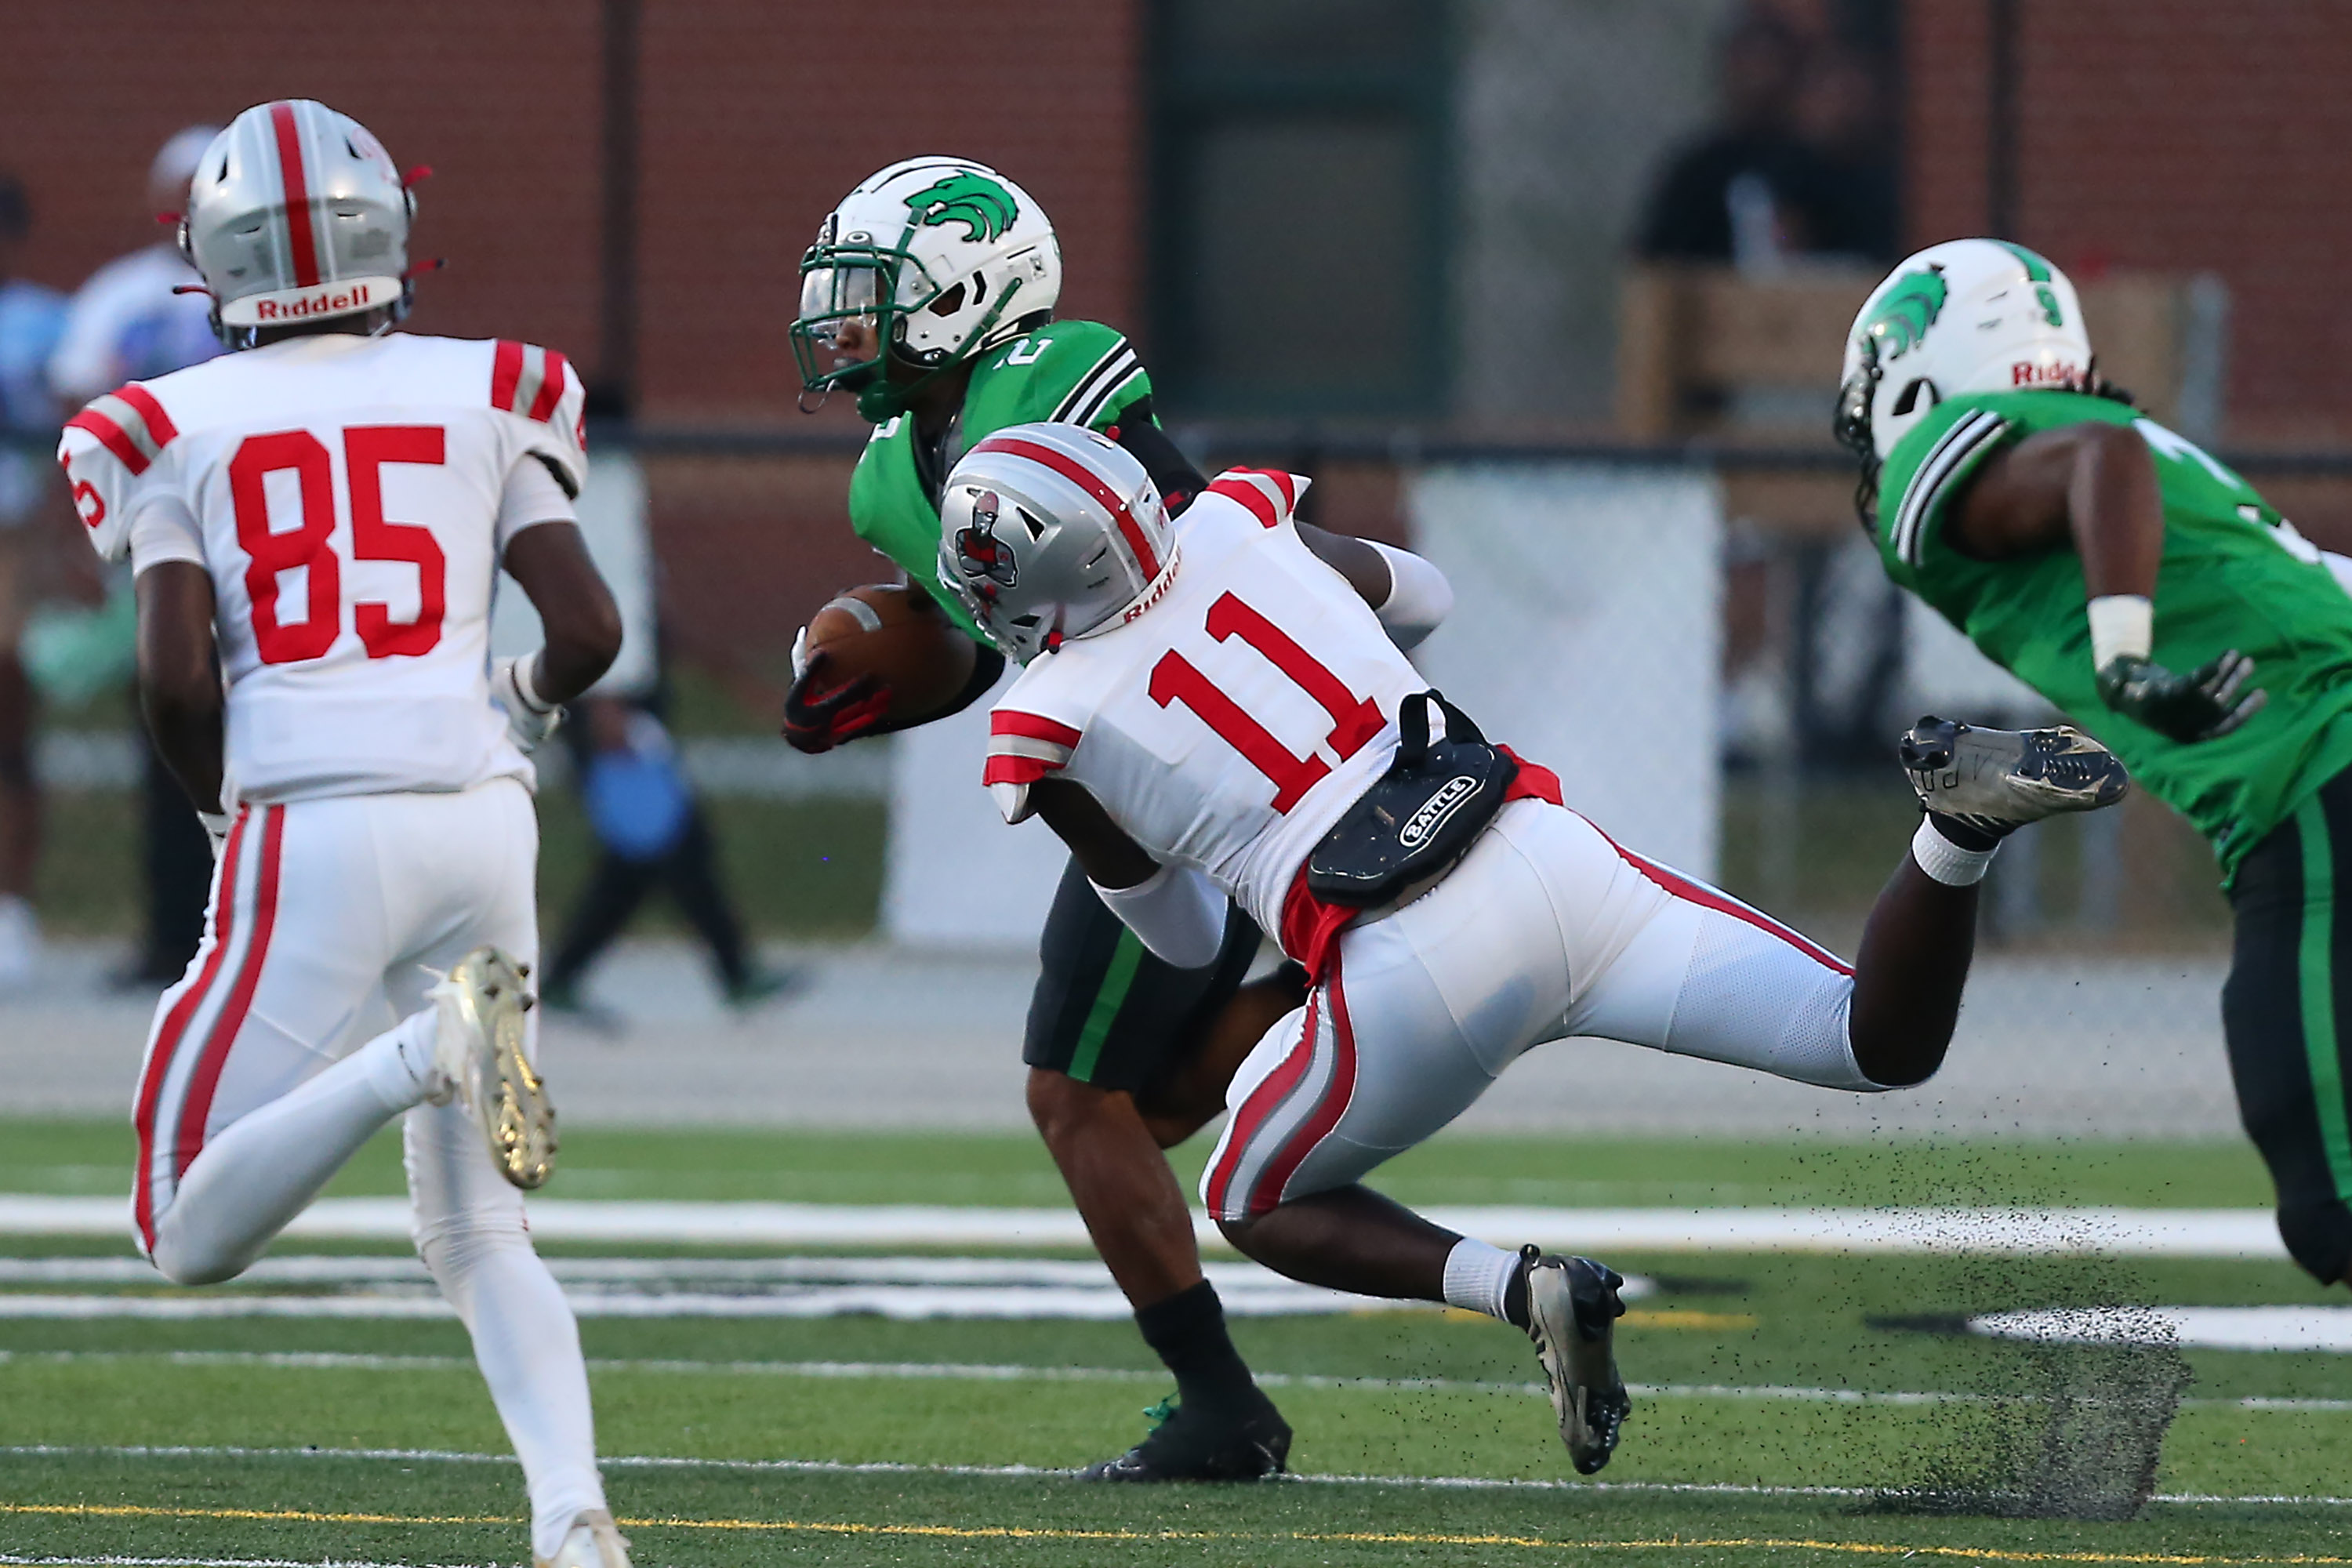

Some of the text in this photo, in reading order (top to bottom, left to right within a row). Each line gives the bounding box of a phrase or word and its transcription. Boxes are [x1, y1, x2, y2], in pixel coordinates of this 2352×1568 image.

[257, 285, 370, 319] Riddell
[229, 425, 445, 665] 85
[1148, 590, 1388, 816] 11
[1406, 780, 1466, 838] BATTLE
